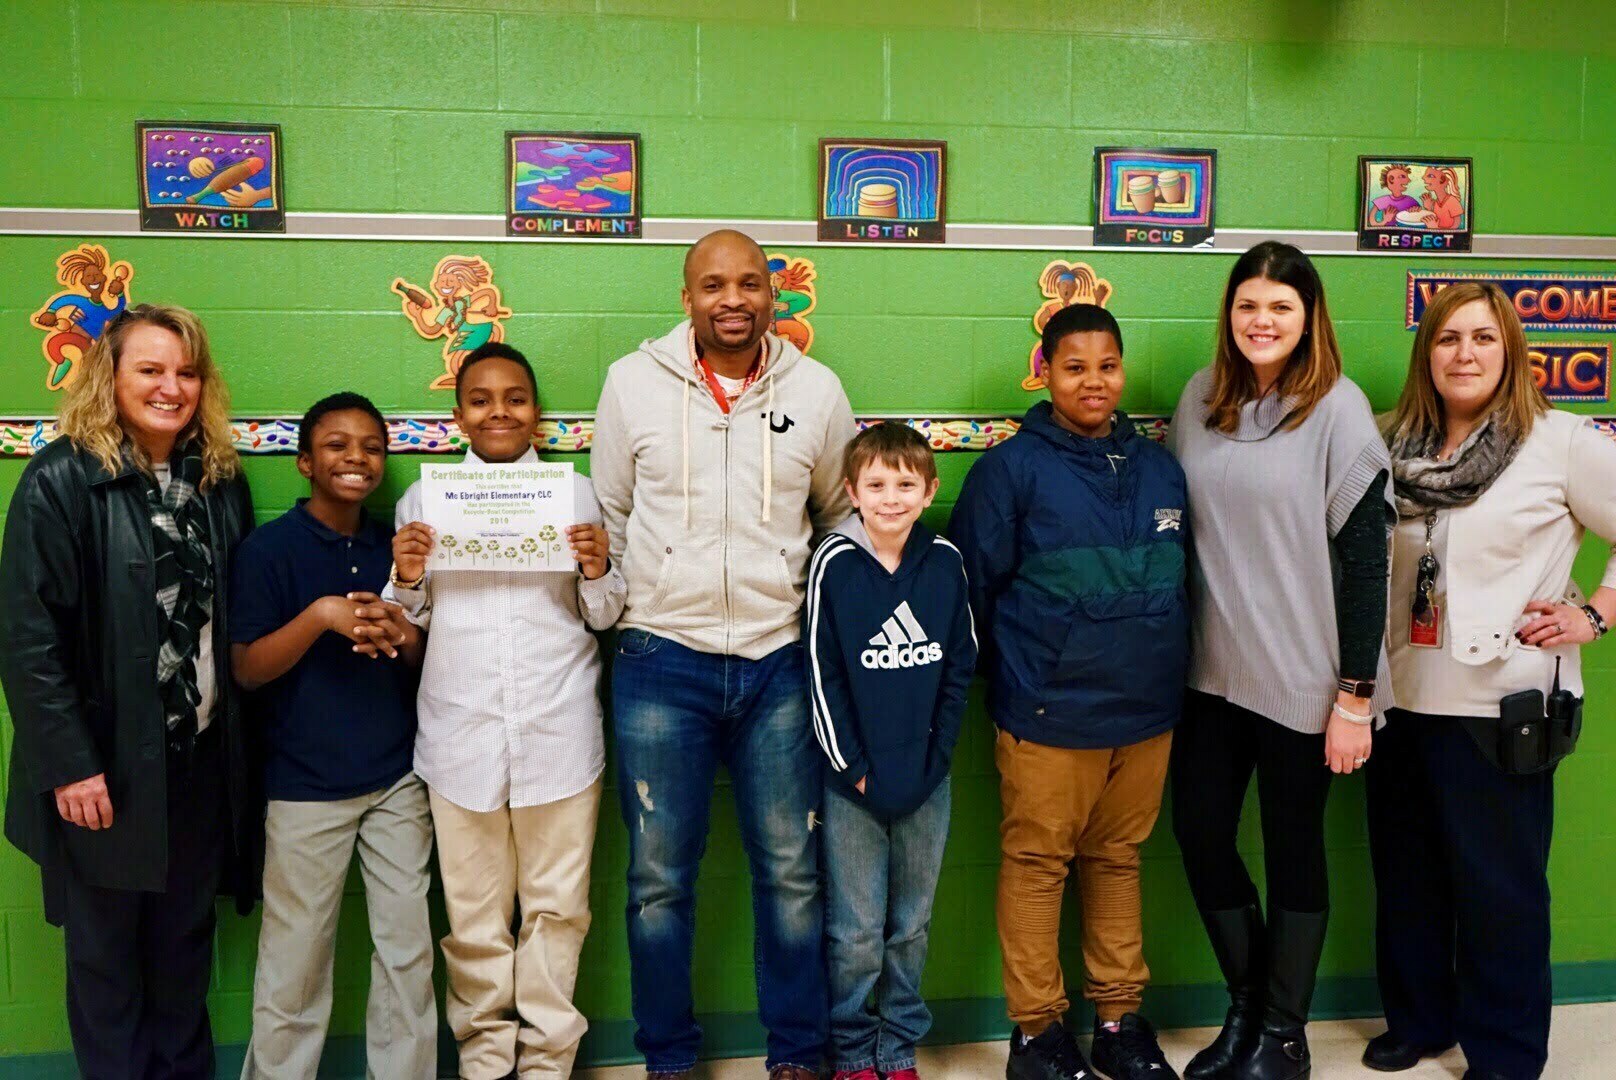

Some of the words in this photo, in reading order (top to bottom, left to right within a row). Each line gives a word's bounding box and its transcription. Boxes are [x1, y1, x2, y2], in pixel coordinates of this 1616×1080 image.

[175, 212, 249, 228] WATCH
[511, 217, 636, 233] COMPLEMENT
[846, 223, 919, 239] LISTEN
[1125, 228, 1184, 243] FOCUS
[1378, 234, 1454, 249] RESPECT
[1528, 351, 1602, 393] SIC
[431, 469, 484, 480] Certificate
[486, 469, 497, 480] of
[499, 468, 565, 481] Participation
[445, 491, 458, 500] Mc
[460, 491, 489, 501] Ebright
[490, 491, 536, 501] Elementary
[537, 490, 552, 499] CLC
[860, 642, 943, 669] adidas
